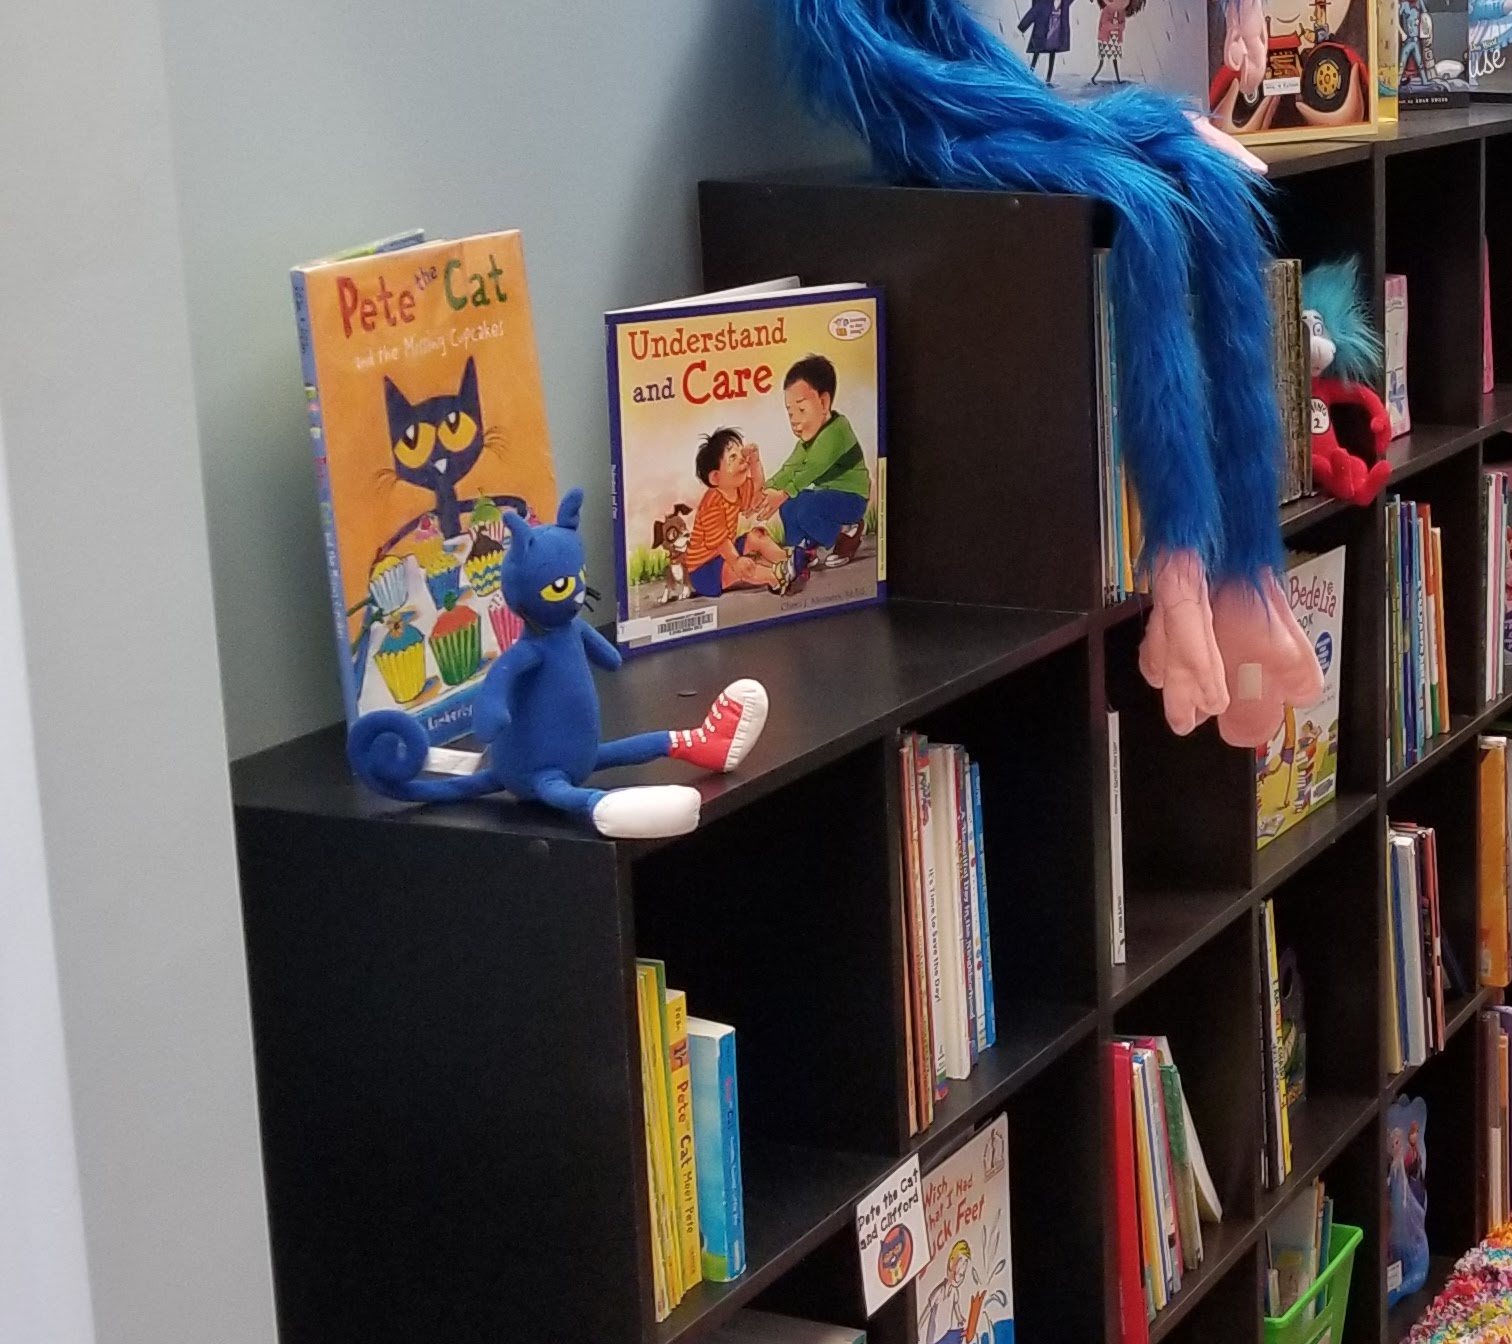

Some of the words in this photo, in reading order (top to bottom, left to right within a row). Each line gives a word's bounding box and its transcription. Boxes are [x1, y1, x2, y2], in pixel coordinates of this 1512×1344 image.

[336, 274, 416, 340] Pete
[413, 265, 439, 292] the
[443, 253, 508, 312] Cat
[628, 316, 788, 362] Understand
[632, 376, 676, 404] and
[681, 359, 774, 406] Care
[1313, 417, 1324, 430] 2
[1289, 575, 1337, 618] Bedelia
[929, 888, 937, 913] Time
[676, 1080, 690, 1124] Pete
[679, 1133, 693, 1169] Cat
[683, 1170, 693, 1203] Meet
[858, 1204, 881, 1233] Pete
[883, 1188, 898, 1208] the
[900, 1167, 919, 1193] Cat
[956, 1172, 973, 1194] Had
[684, 1206, 694, 1234] Pete
[860, 1226, 878, 1251] and
[880, 1186, 919, 1233] Clifford
[956, 1193, 985, 1235] Feet
